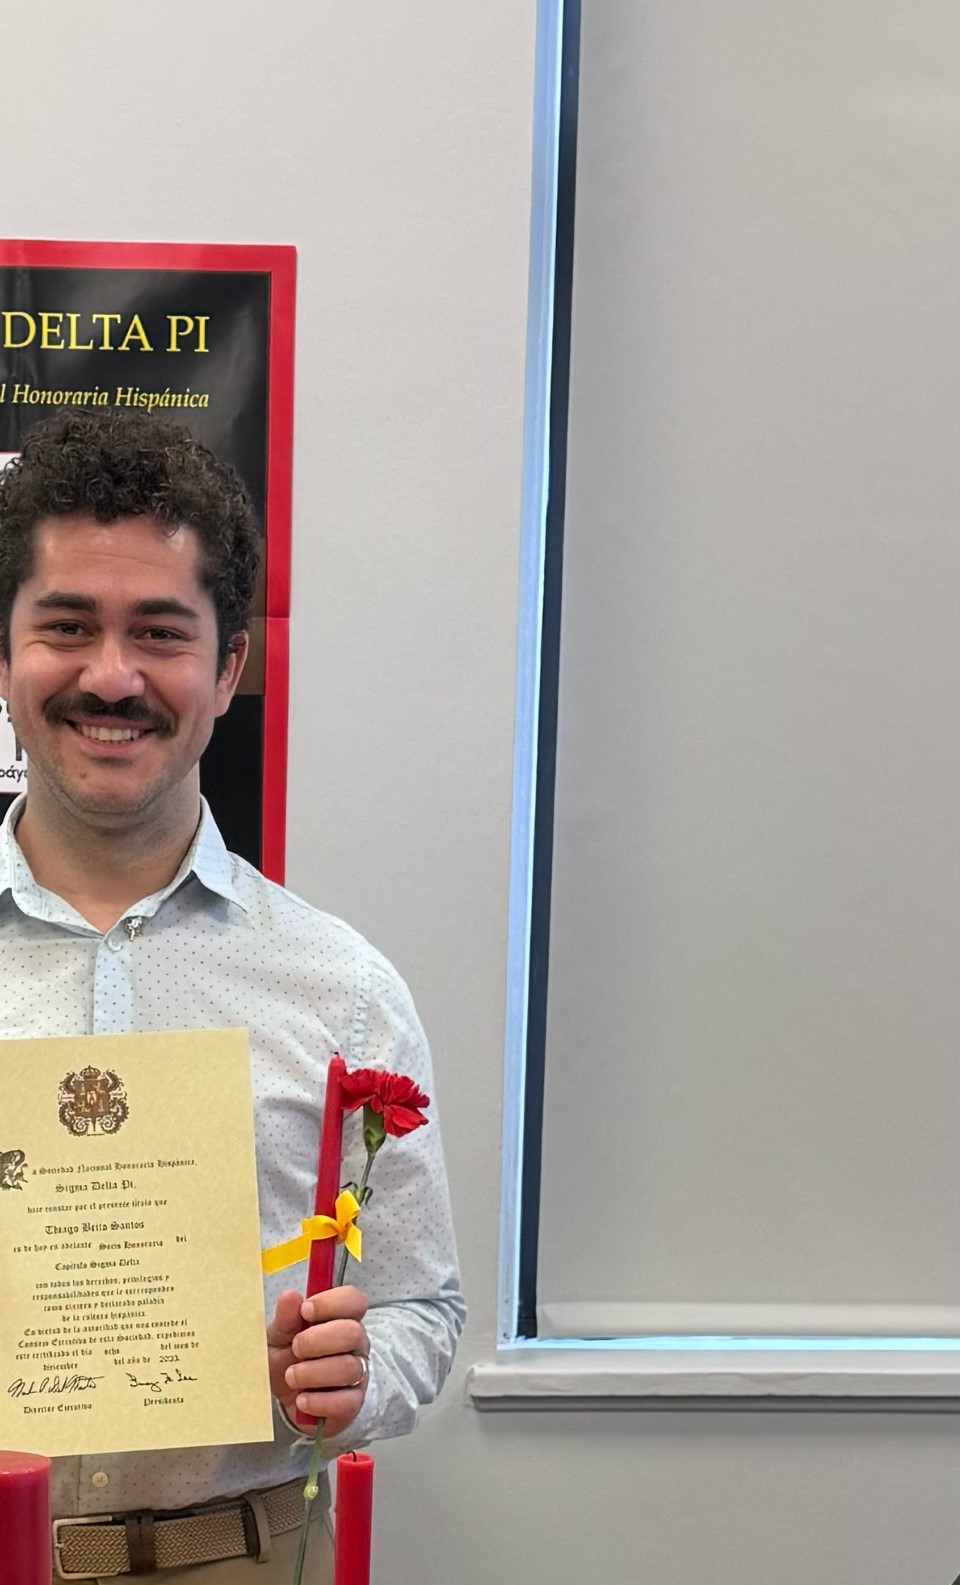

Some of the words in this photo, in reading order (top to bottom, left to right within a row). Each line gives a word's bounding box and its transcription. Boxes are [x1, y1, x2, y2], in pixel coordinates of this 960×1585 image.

[2, 310, 154, 352] DELTA
[166, 315, 210, 353] PI
[12, 384, 109, 407] Honoraria
[114, 386, 210, 411] Hispánica
[55, 1183, 88, 1193] Sigma
[90, 1181, 118, 1190] Delta
[110, 1221, 145, 1231] Santos
